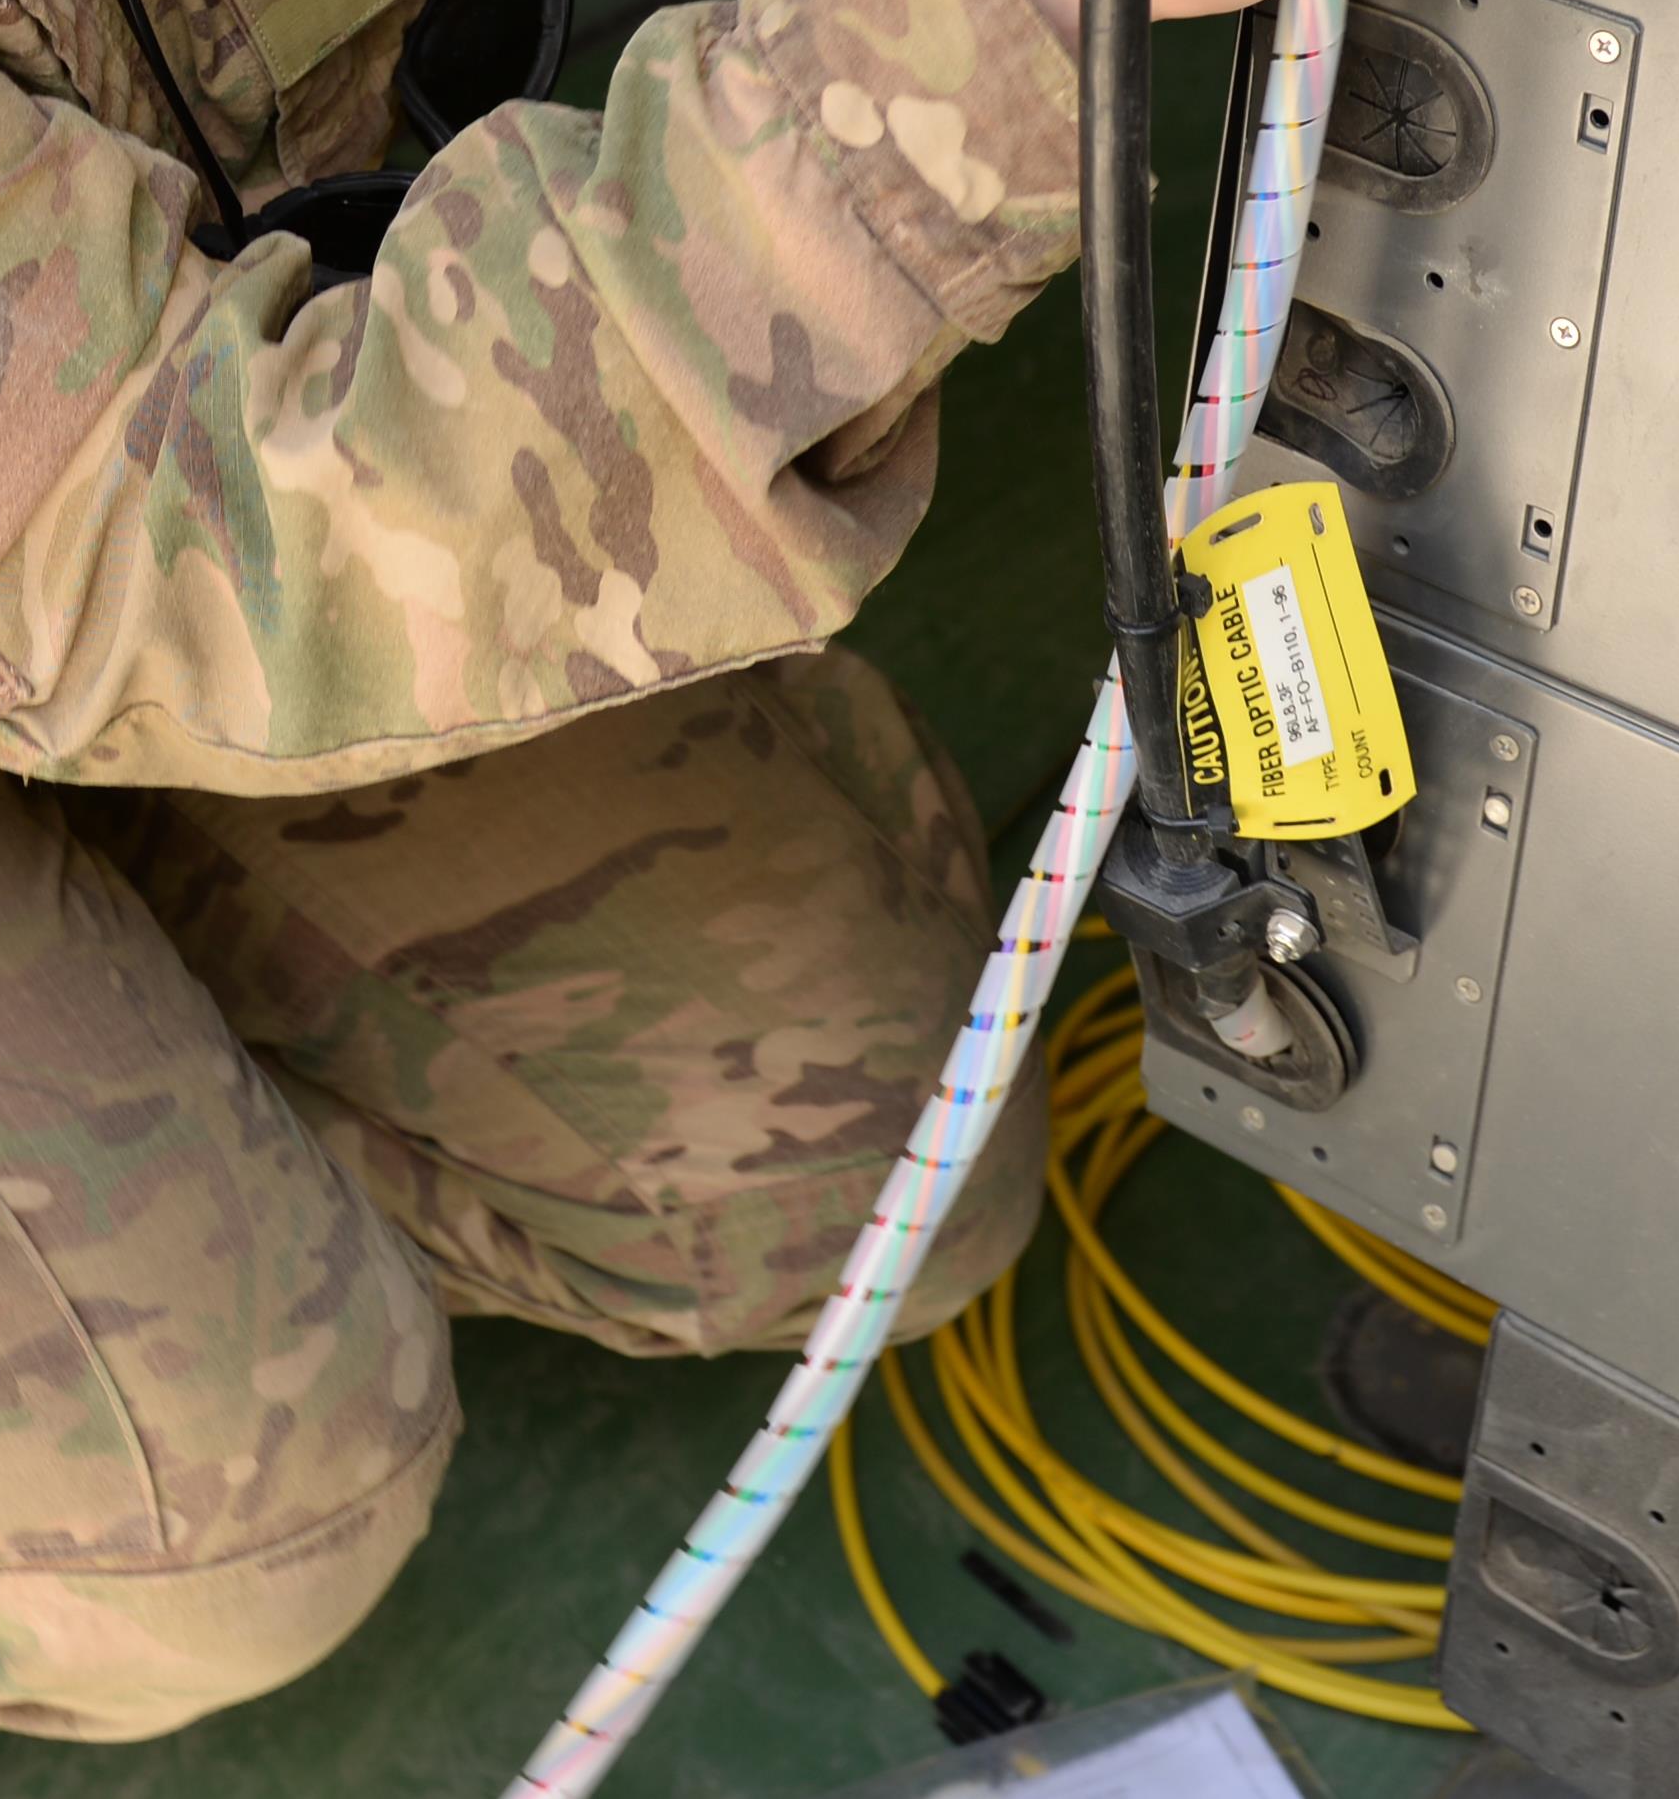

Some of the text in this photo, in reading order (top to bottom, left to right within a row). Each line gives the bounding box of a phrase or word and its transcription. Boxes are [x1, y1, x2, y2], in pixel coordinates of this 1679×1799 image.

[1272, 584, 1292, 623] 1-96
[1216, 583, 1286, 798] FIBER OPTIC CABLE
[1321, 753, 1340, 791] TYPE
[1351, 729, 1373, 779] COUNT
